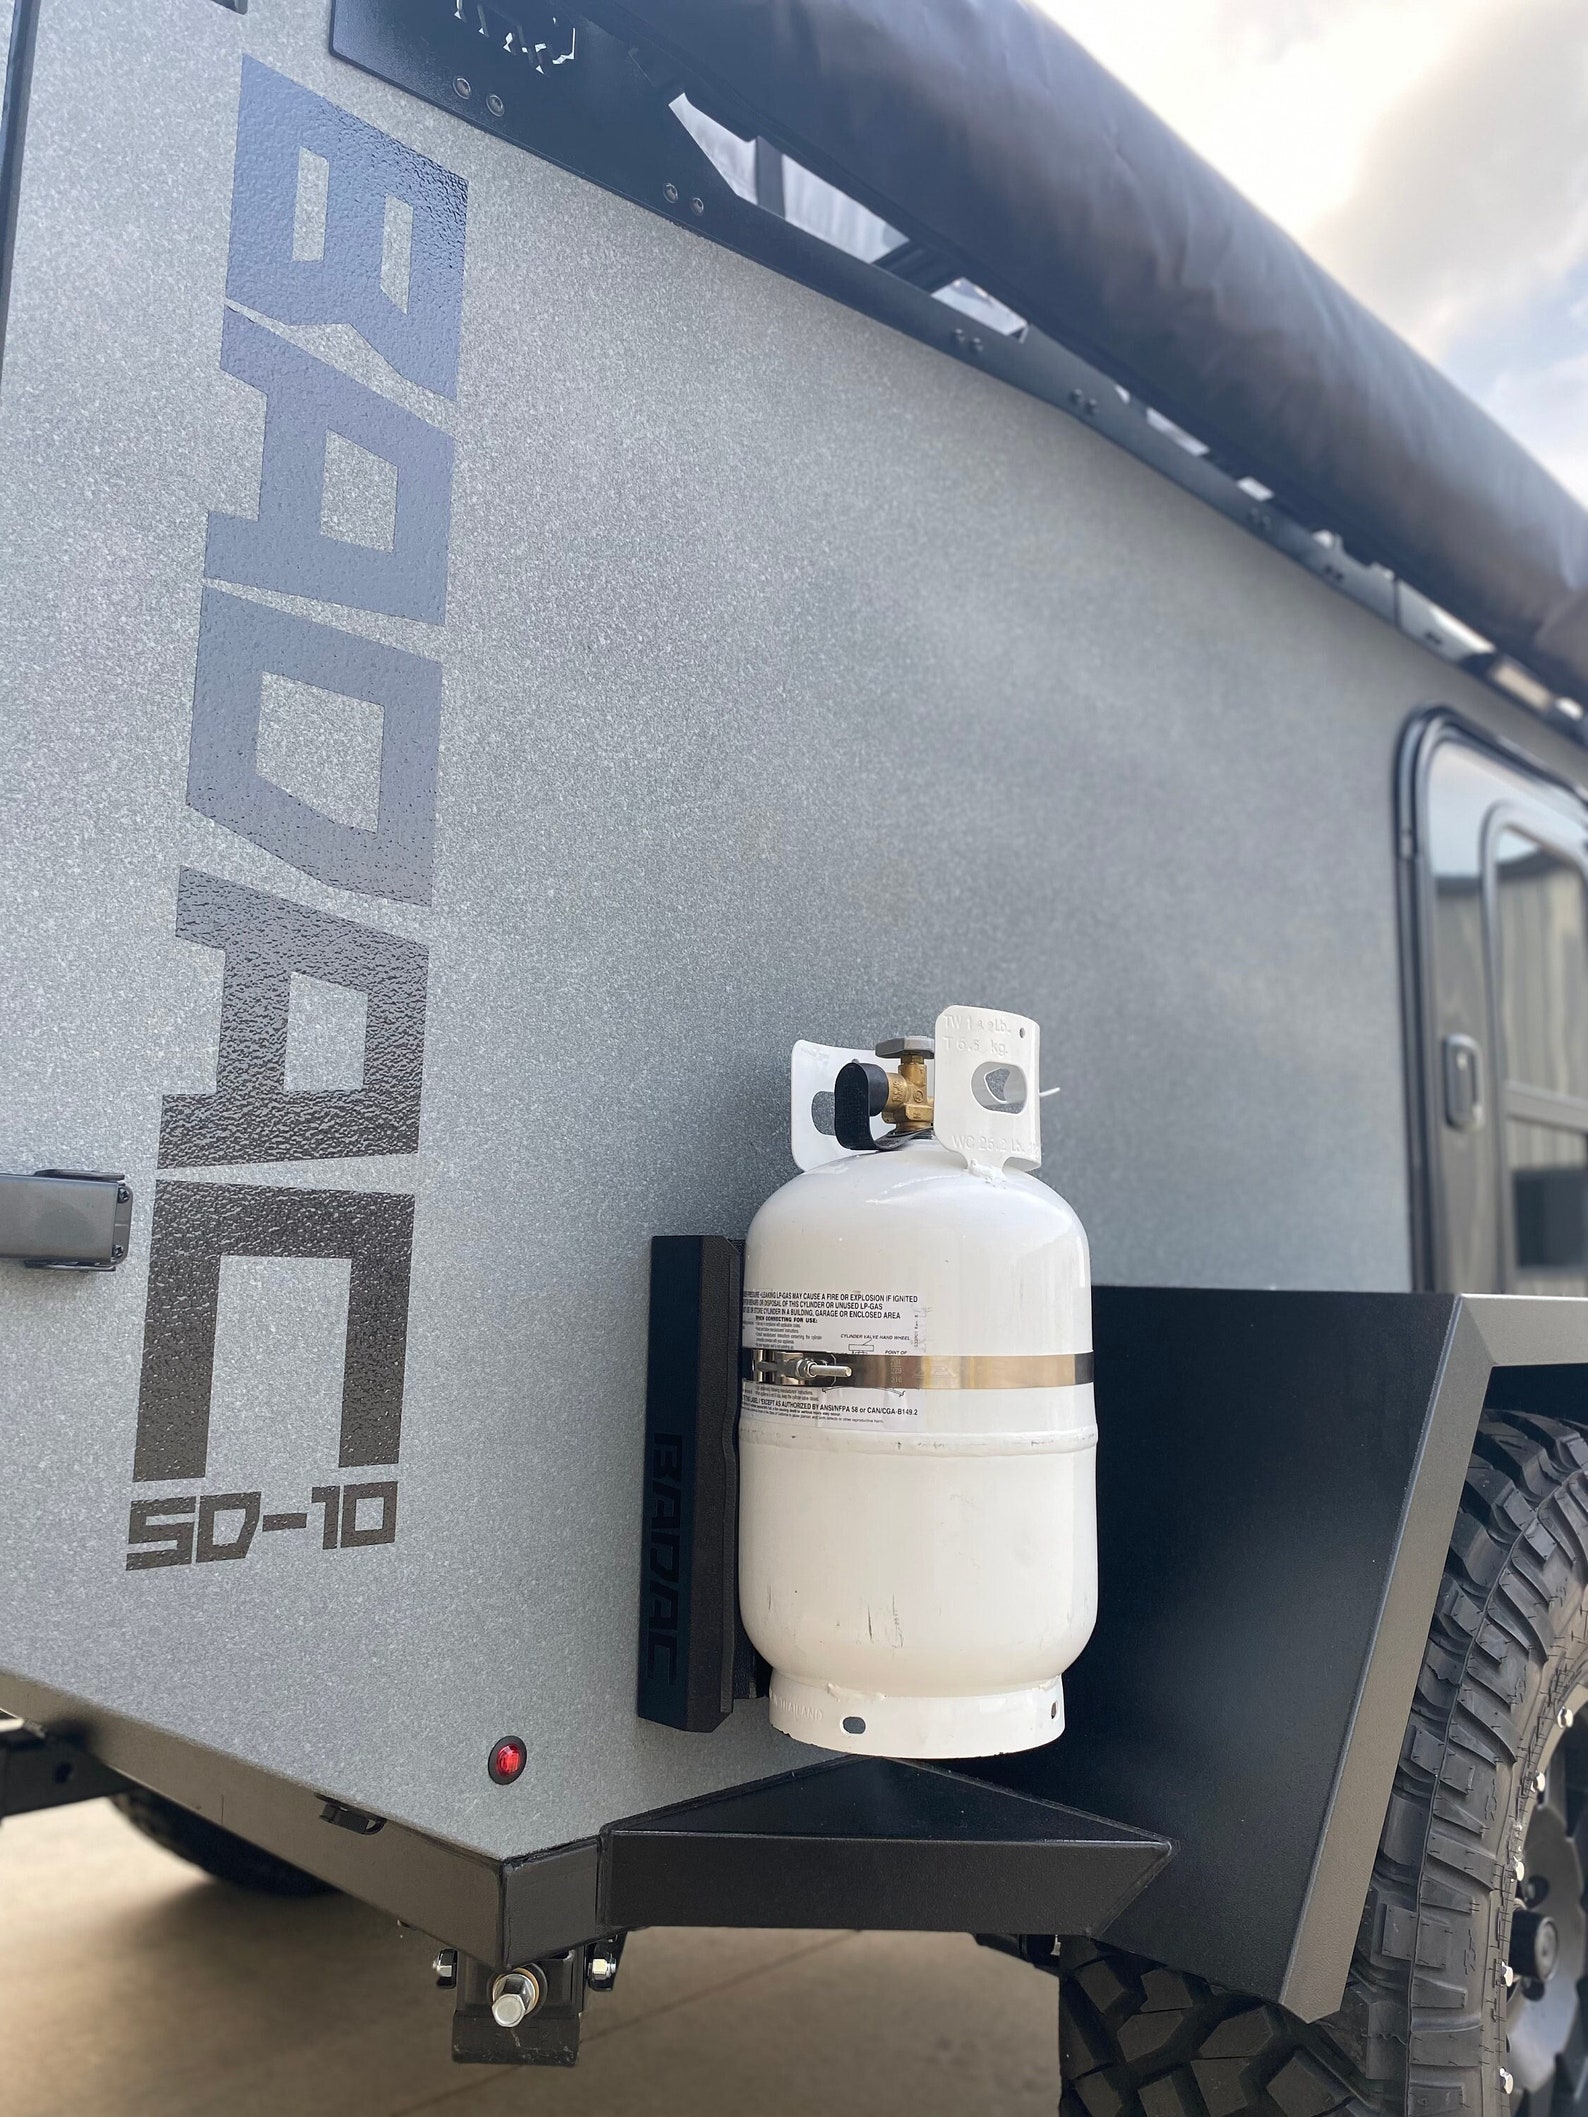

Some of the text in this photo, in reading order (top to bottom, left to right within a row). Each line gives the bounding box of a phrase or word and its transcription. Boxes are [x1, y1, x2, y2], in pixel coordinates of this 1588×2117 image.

[133, 54, 468, 1482] BADAC
[792, 1292, 803, 1300] MAY
[803, 1293, 821, 1301] CAUSE
[826, 1293, 839, 1301] FIRE
[840, 1293, 850, 1301] OR
[850, 1294, 885, 1303] EXPLOSION
[886, 1295, 892, 1303] IF
[893, 1295, 918, 1303] IGNITED
[800, 1301, 825, 1309] CYLINDER
[835, 1302, 860, 1310] UNUSED
[860, 1303, 883, 1311] LP-GAS
[790, 1309, 815, 1317] BUILDING,
[815, 1310, 839, 1318] GARAGE
[849, 1311, 883, 1319] ENCLOSED
[883, 1311, 901, 1320] AREA
[782, 1400, 812, 1410] AUTHORIZED
[812, 1403, 819, 1411] BY
[819, 1404, 850, 1413] ANSI/NFPA
[126, 1480, 399, 1571] SD-10
[648, 1432, 683, 1685] BADAC
